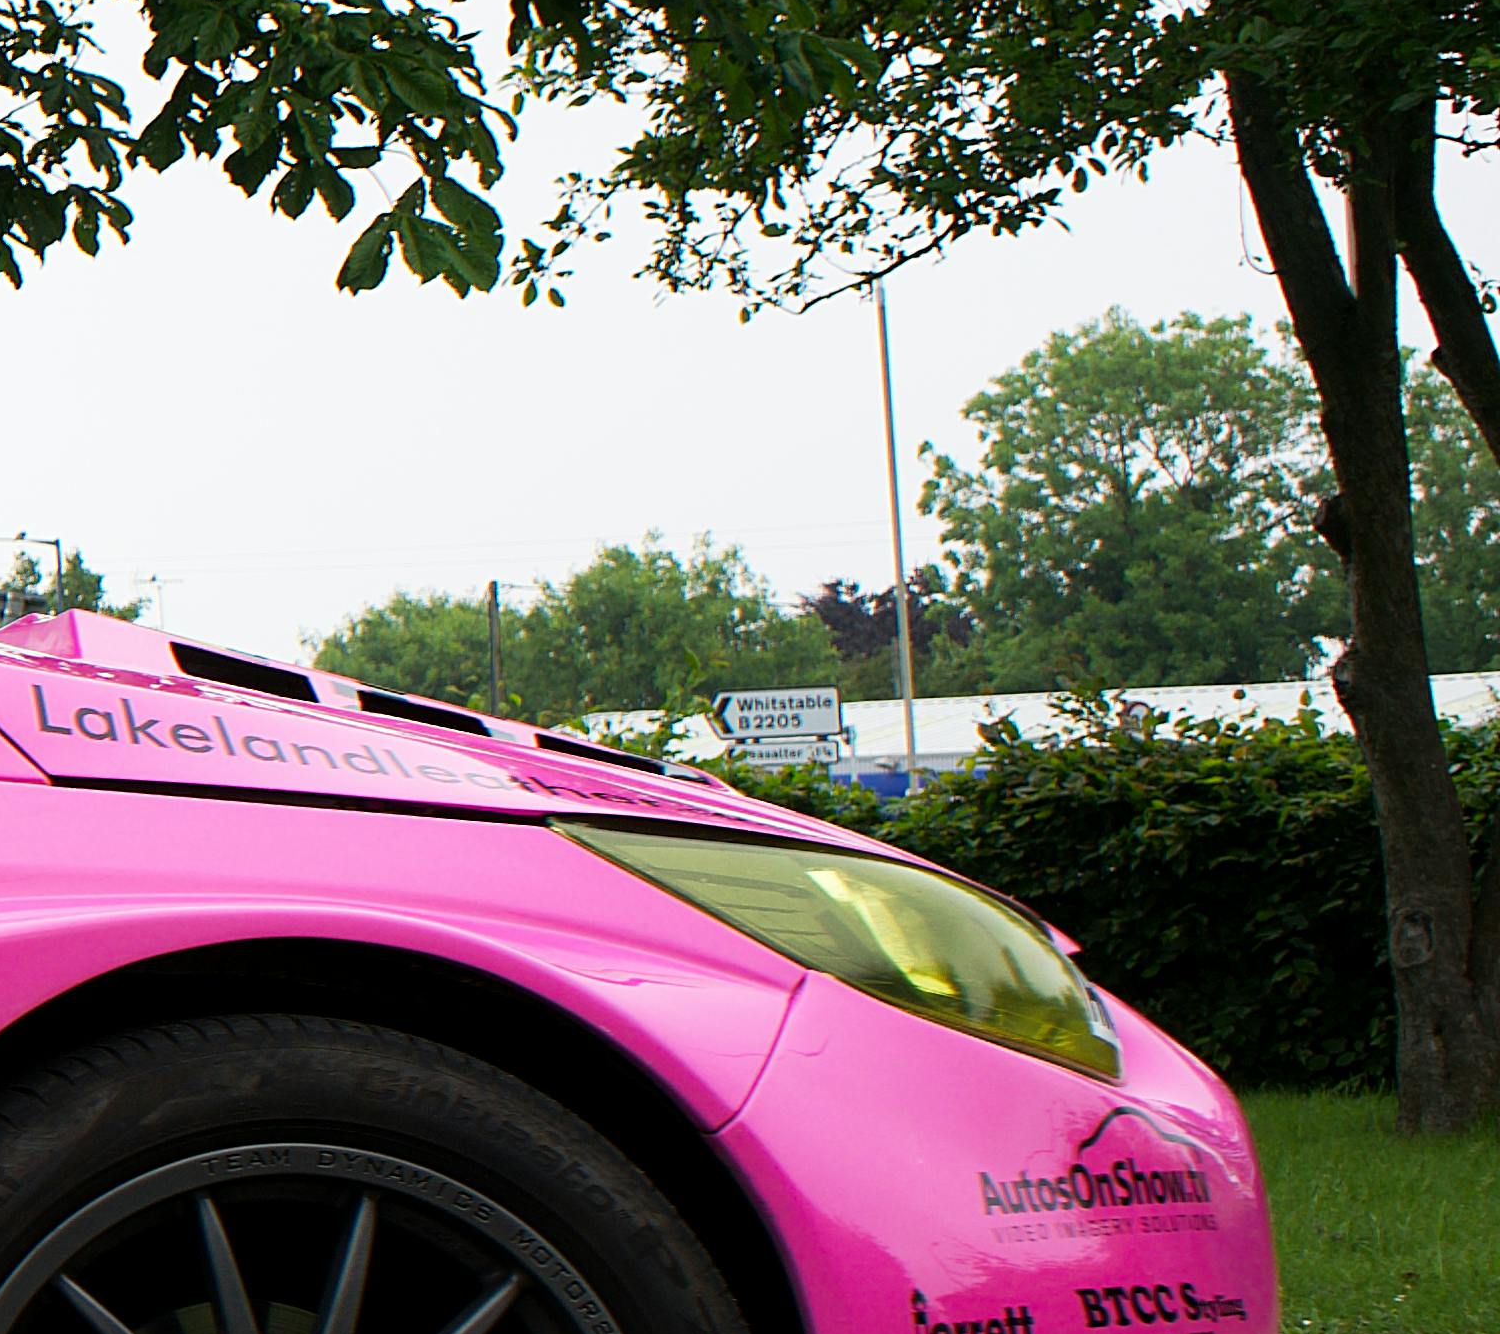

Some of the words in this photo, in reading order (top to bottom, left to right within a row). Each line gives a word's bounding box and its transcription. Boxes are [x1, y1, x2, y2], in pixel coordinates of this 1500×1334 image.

[736, 694, 833, 713] Whitstable
[201, 1147, 292, 1176] TEAM
[317, 1150, 494, 1223] DYNAMICS
[990, 1223, 1049, 1244] VIDEO
[1076, 1284, 1178, 1328] BTCC
